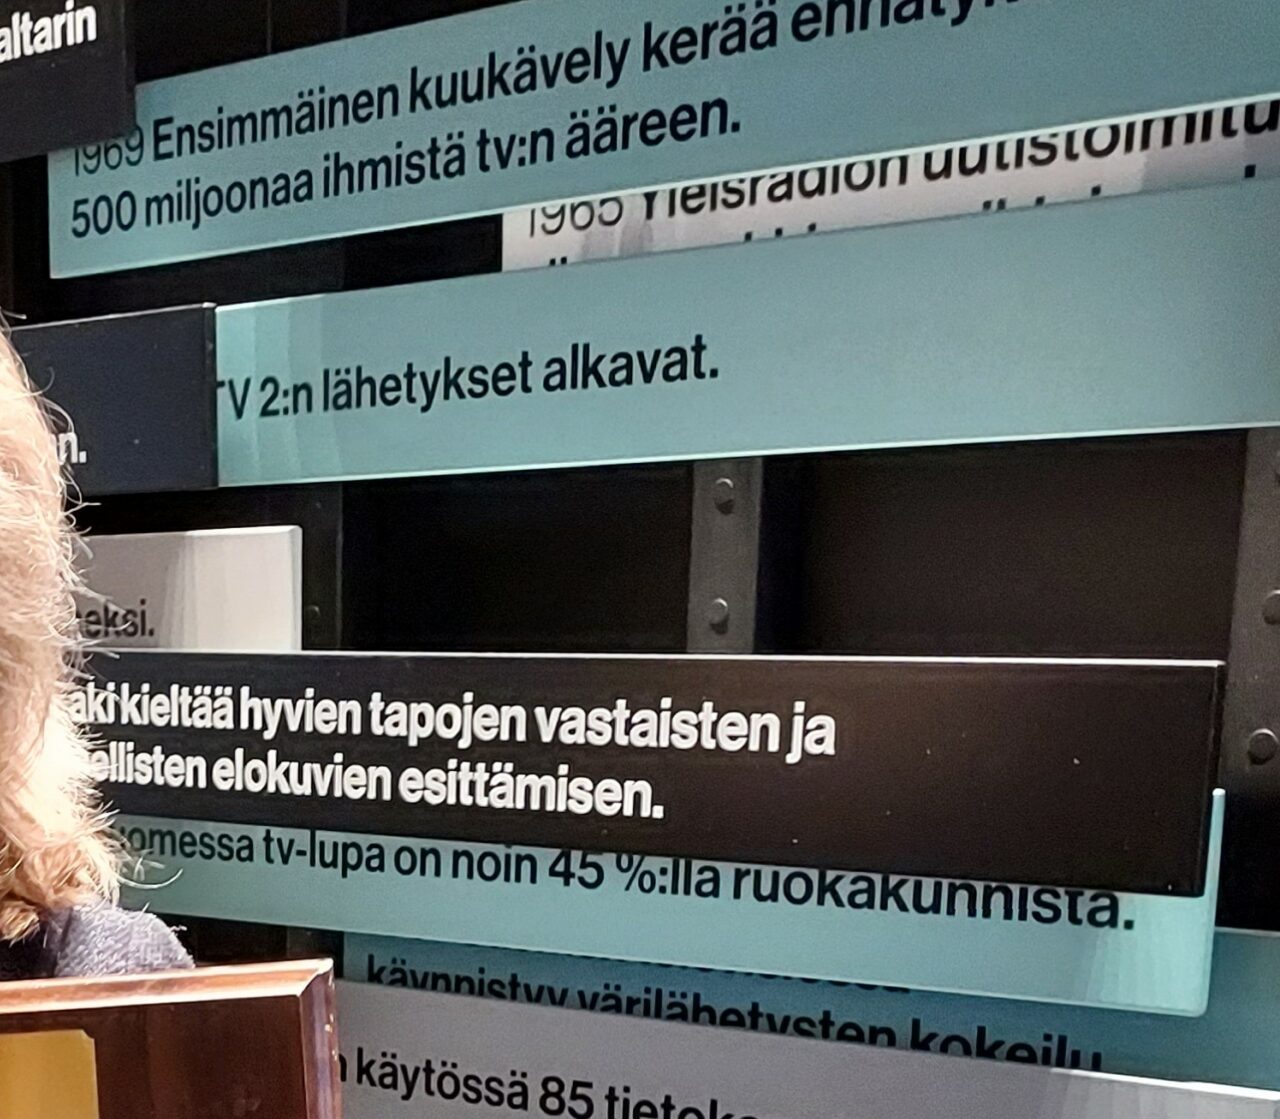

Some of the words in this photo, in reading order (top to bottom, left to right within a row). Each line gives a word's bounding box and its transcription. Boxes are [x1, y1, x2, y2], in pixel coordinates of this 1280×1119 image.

[150, 82, 400, 163] Ensimmäinen
[407, 30, 632, 114] kuukävely
[642, 1, 779, 73] kerää
[70, 189, 137, 240] 500
[144, 165, 315, 233] miljoonaa
[320, 131, 467, 200] ihmistä
[477, 124, 555, 173] tv:n
[565, 96, 742, 161] ääreen.
[260, 374, 313, 419] 2:n
[321, 350, 533, 414] lähetykset
[542, 333, 719, 393] alkavat.
[120, 682, 235, 730] kieltää
[239, 685, 362, 740] hyvien
[369, 692, 527, 750] tapojen
[533, 697, 781, 755] vastaisten
[784, 700, 837, 765] ja
[212, 747, 392, 802] elokuvien
[397, 757, 665, 820] esittämisen.
[263, 828, 386, 879] tv-lupa
[394, 845, 442, 876] on
[451, 844, 538, 885] noin
[549, 848, 606, 890] 45
[615, 851, 722, 899] %:lla
[732, 866, 1135, 931] ruokakunnista.
[356, 1046, 529, 1111] käytössä
